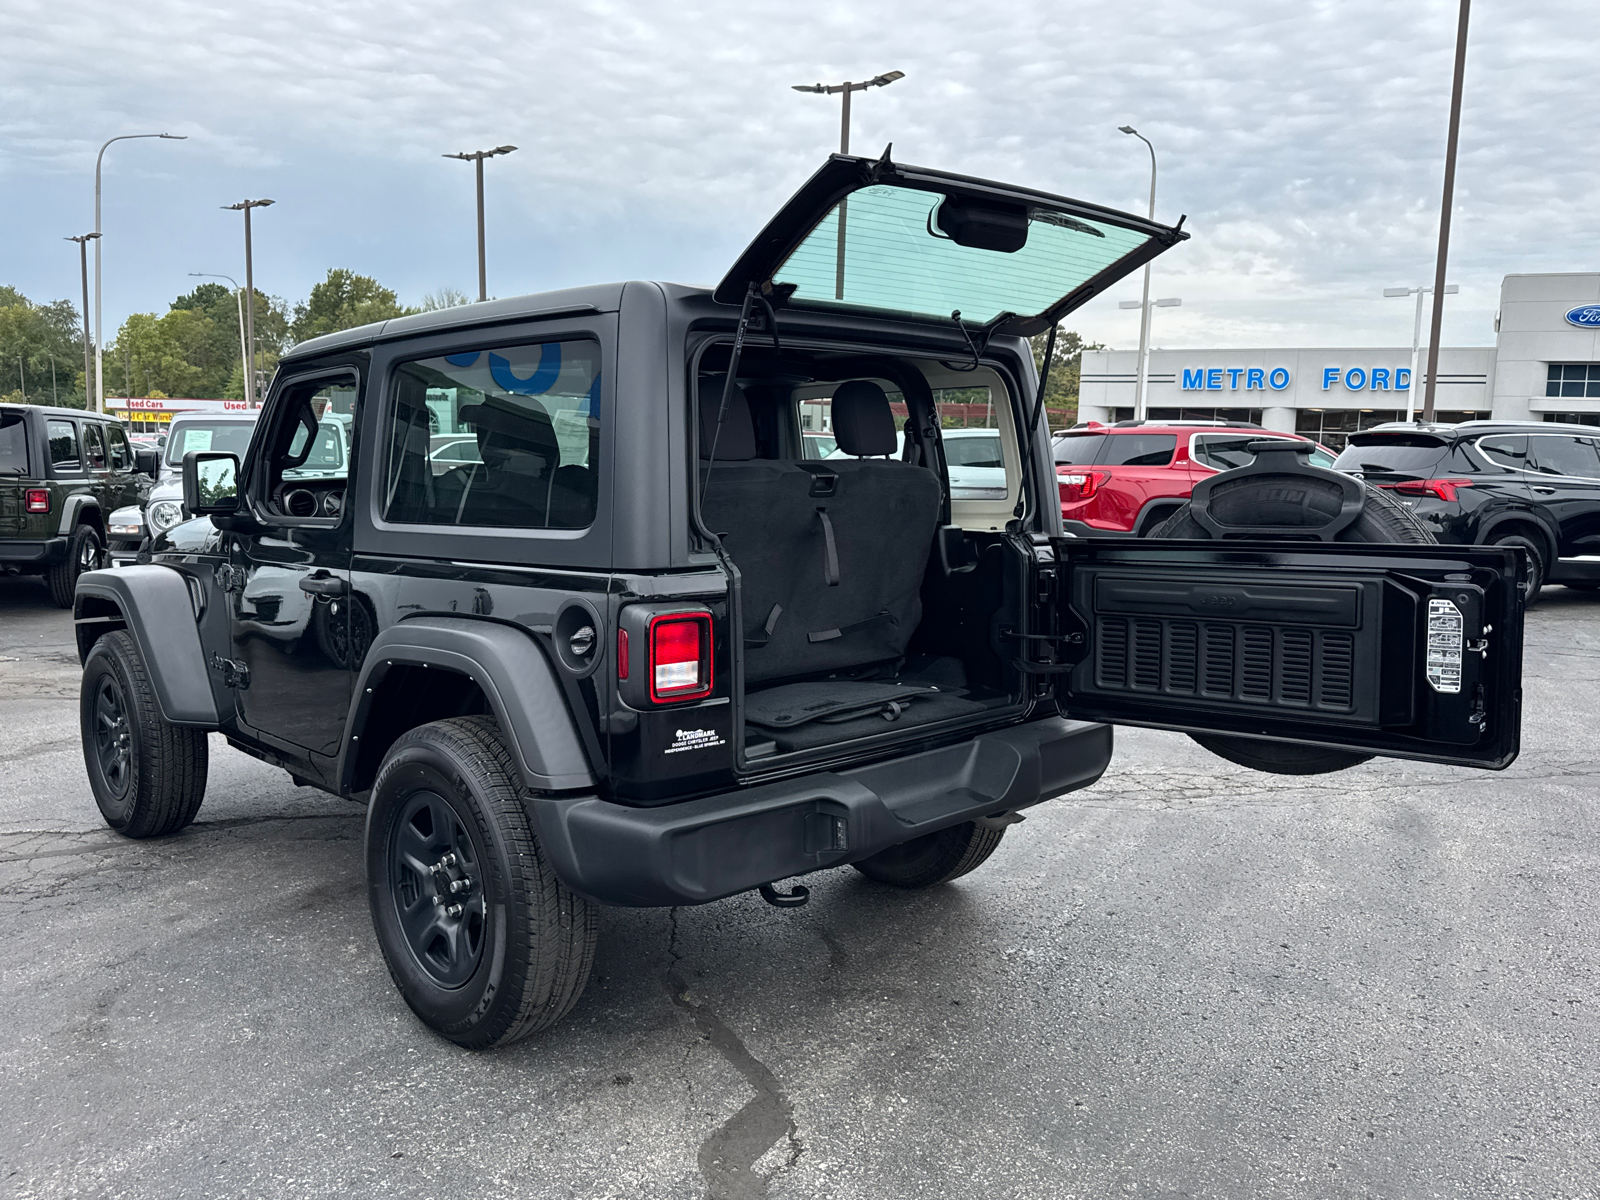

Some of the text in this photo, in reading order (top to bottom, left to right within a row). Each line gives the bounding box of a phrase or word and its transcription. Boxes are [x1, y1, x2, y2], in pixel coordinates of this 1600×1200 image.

[1182, 367, 1412, 391] METRO FORD
[146, 400, 163, 408] Cars
[224, 401, 247, 410] Used
[682, 730, 716, 740] LANDMARK
[474, 982, 496, 1020] LTX
